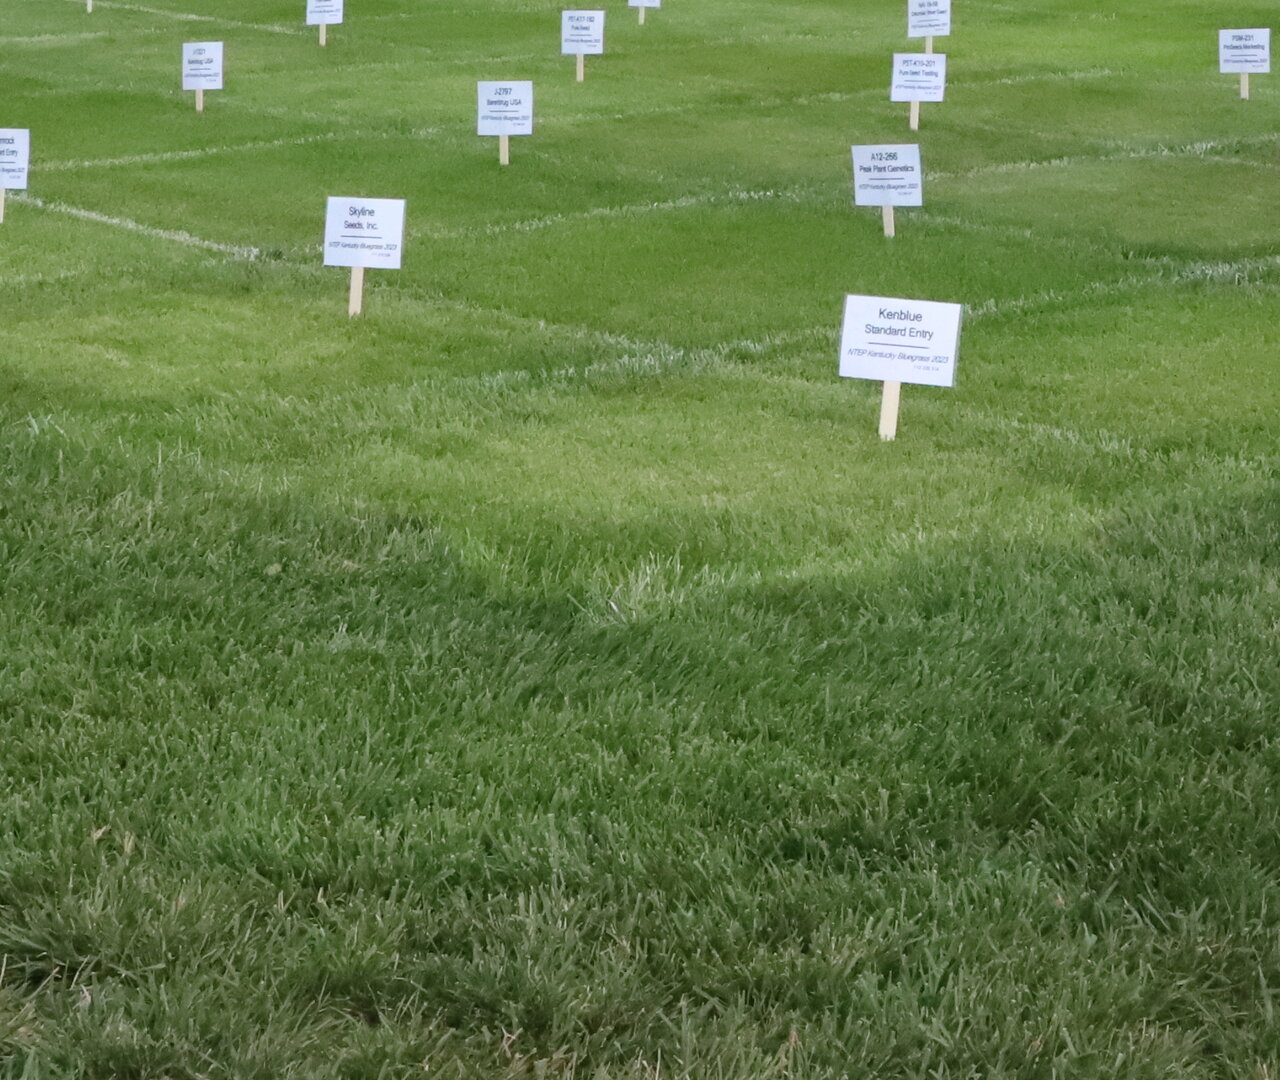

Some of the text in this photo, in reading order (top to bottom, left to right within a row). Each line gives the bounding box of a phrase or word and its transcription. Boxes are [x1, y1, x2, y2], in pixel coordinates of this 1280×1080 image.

[887, 164, 915, 173] Genetics
[348, 206, 376, 219] Skyline
[343, 220, 379, 231] Seeds, Inc.
[878, 307, 923, 322] Kenblue
[864, 323, 934, 341] Standard Entry
[847, 348, 950, 364] NTEP Kentucky Bluegrass 2023
